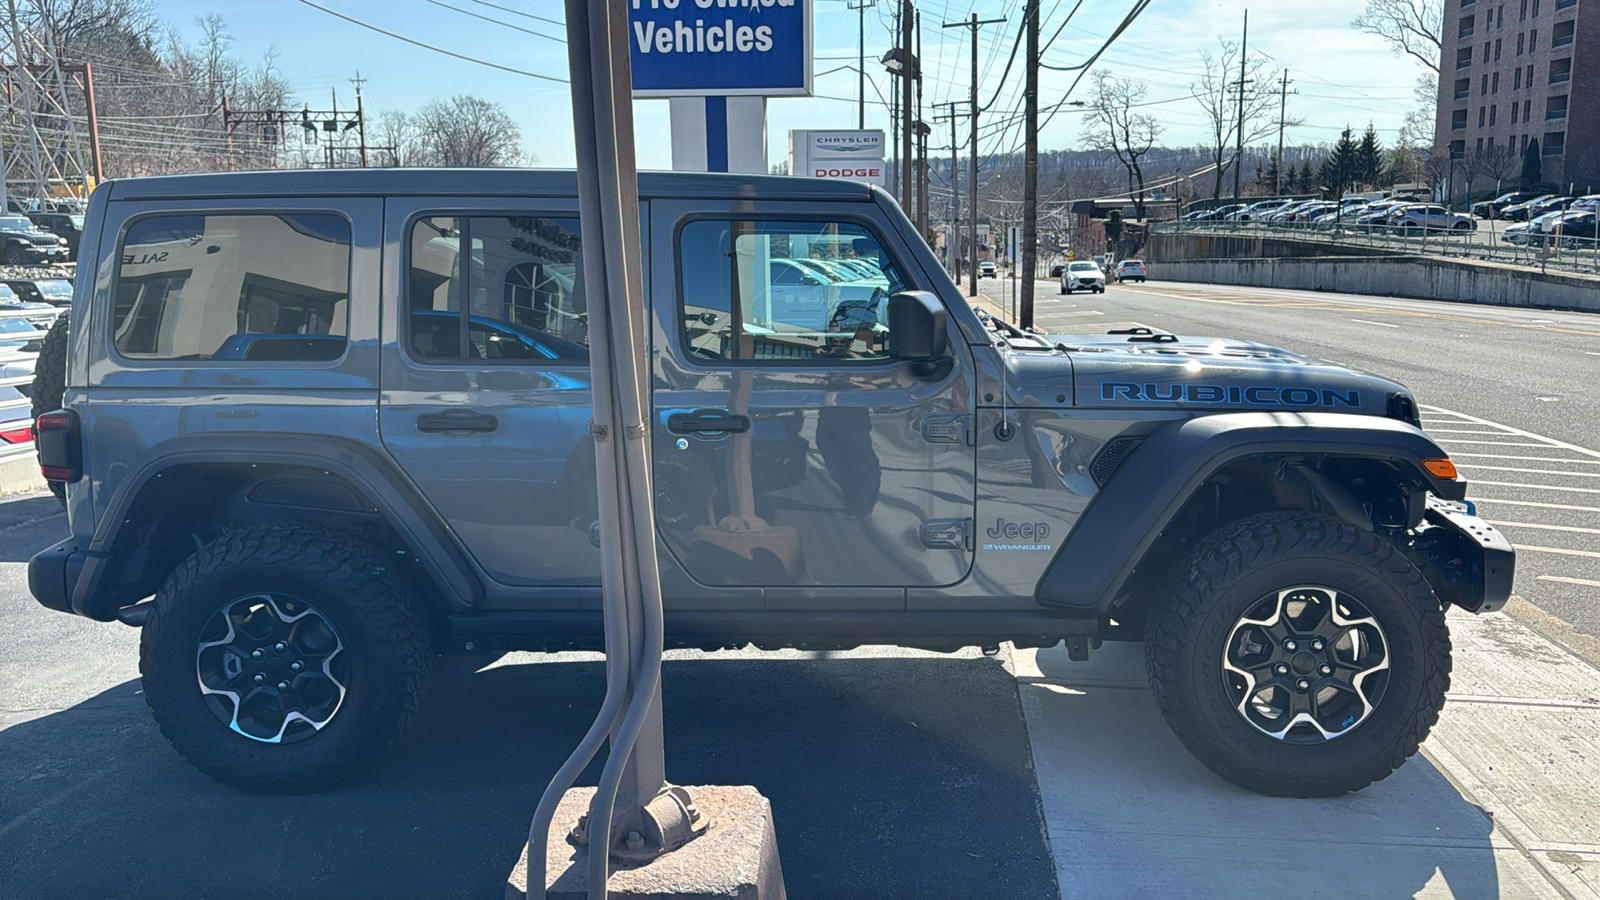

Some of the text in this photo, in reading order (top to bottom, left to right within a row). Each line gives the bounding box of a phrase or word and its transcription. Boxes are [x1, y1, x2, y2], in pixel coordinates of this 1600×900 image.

[633, 19, 773, 53] Vehicles
[815, 168, 880, 177] DODGE
[1100, 382, 1361, 408] RUBICON
[986, 517, 1051, 542] Jeep
